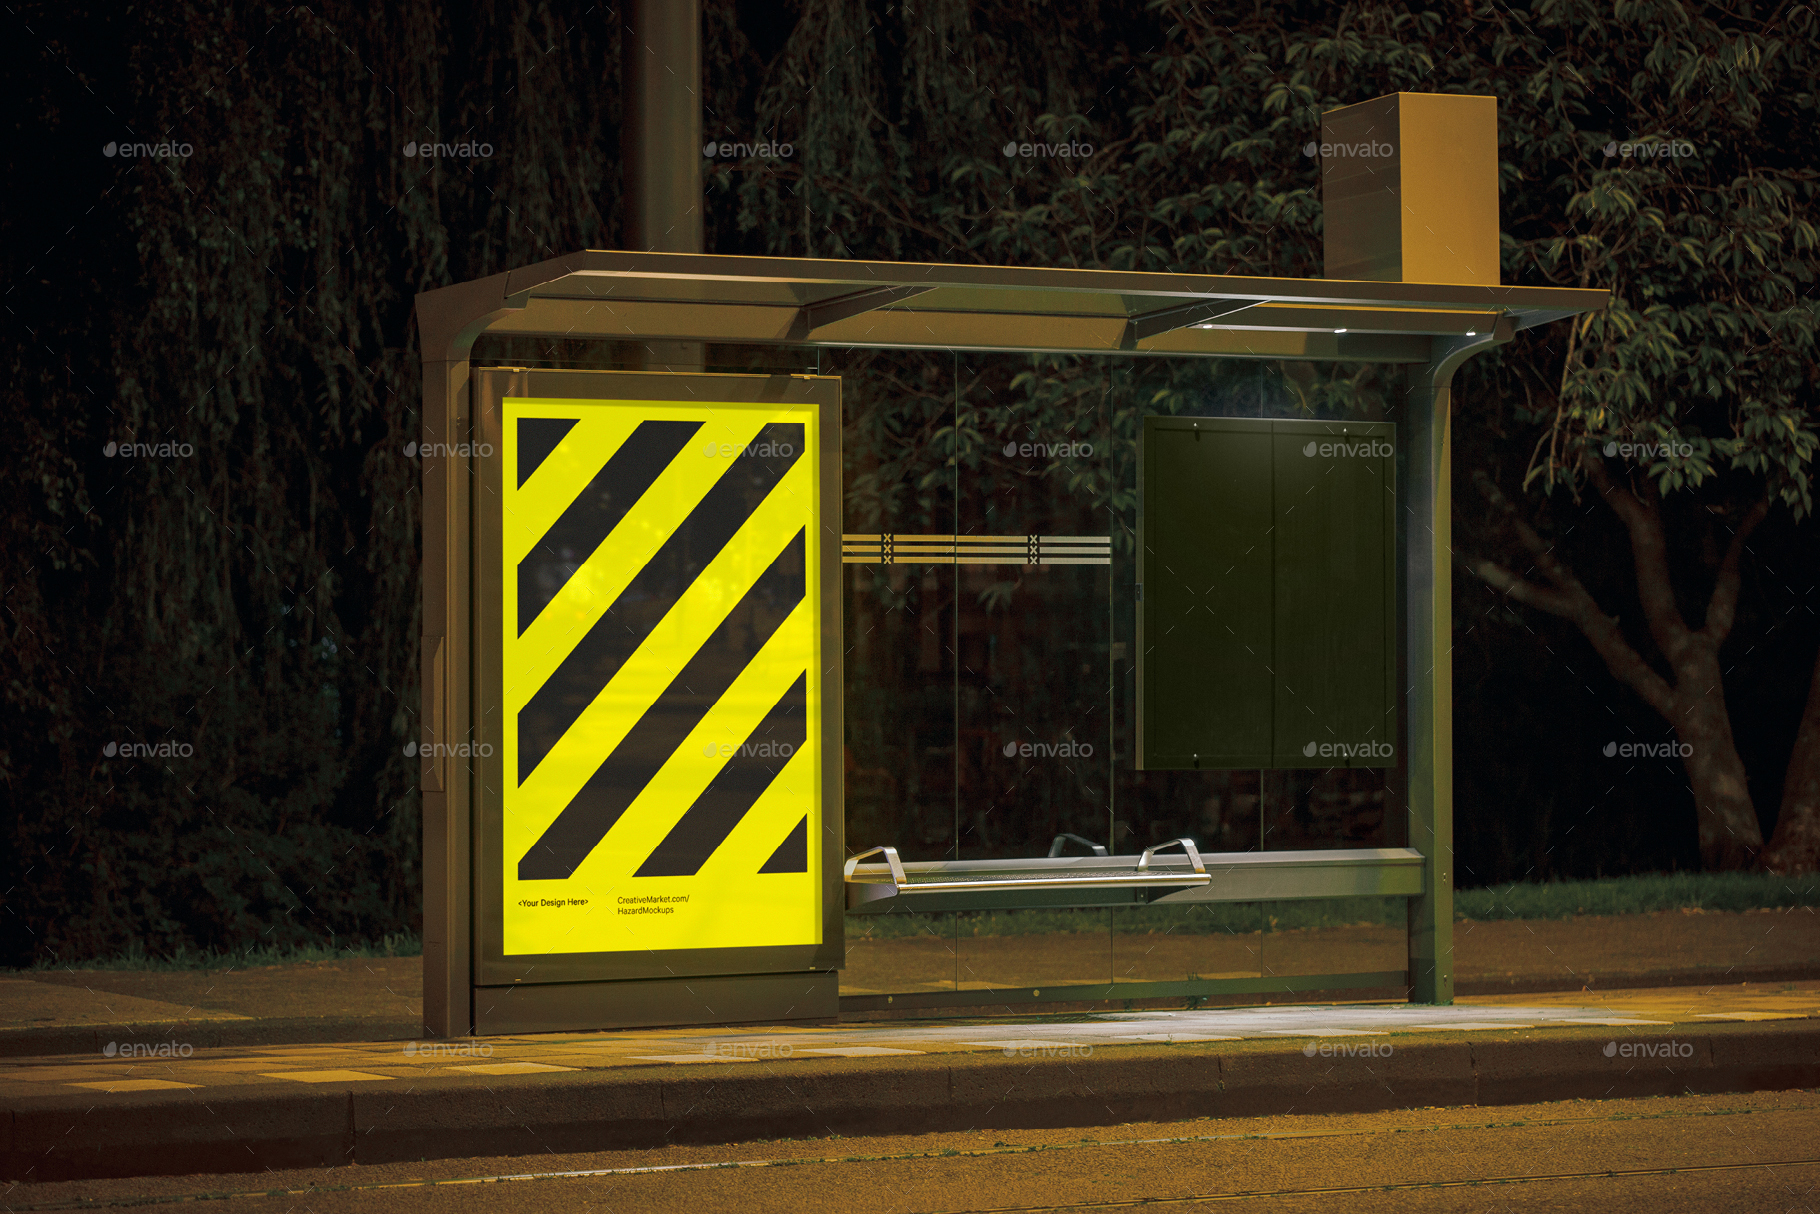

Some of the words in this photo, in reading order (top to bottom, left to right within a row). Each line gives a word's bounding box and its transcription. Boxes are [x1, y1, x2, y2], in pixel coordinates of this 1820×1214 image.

[518, 899, 539, 907] <Your
[540, 898, 566, 908] Design
[567, 897, 589, 906] Here>
[617, 894, 690, 905] CreativeMarket.com/
[617, 905, 674, 916] HazardMockups
